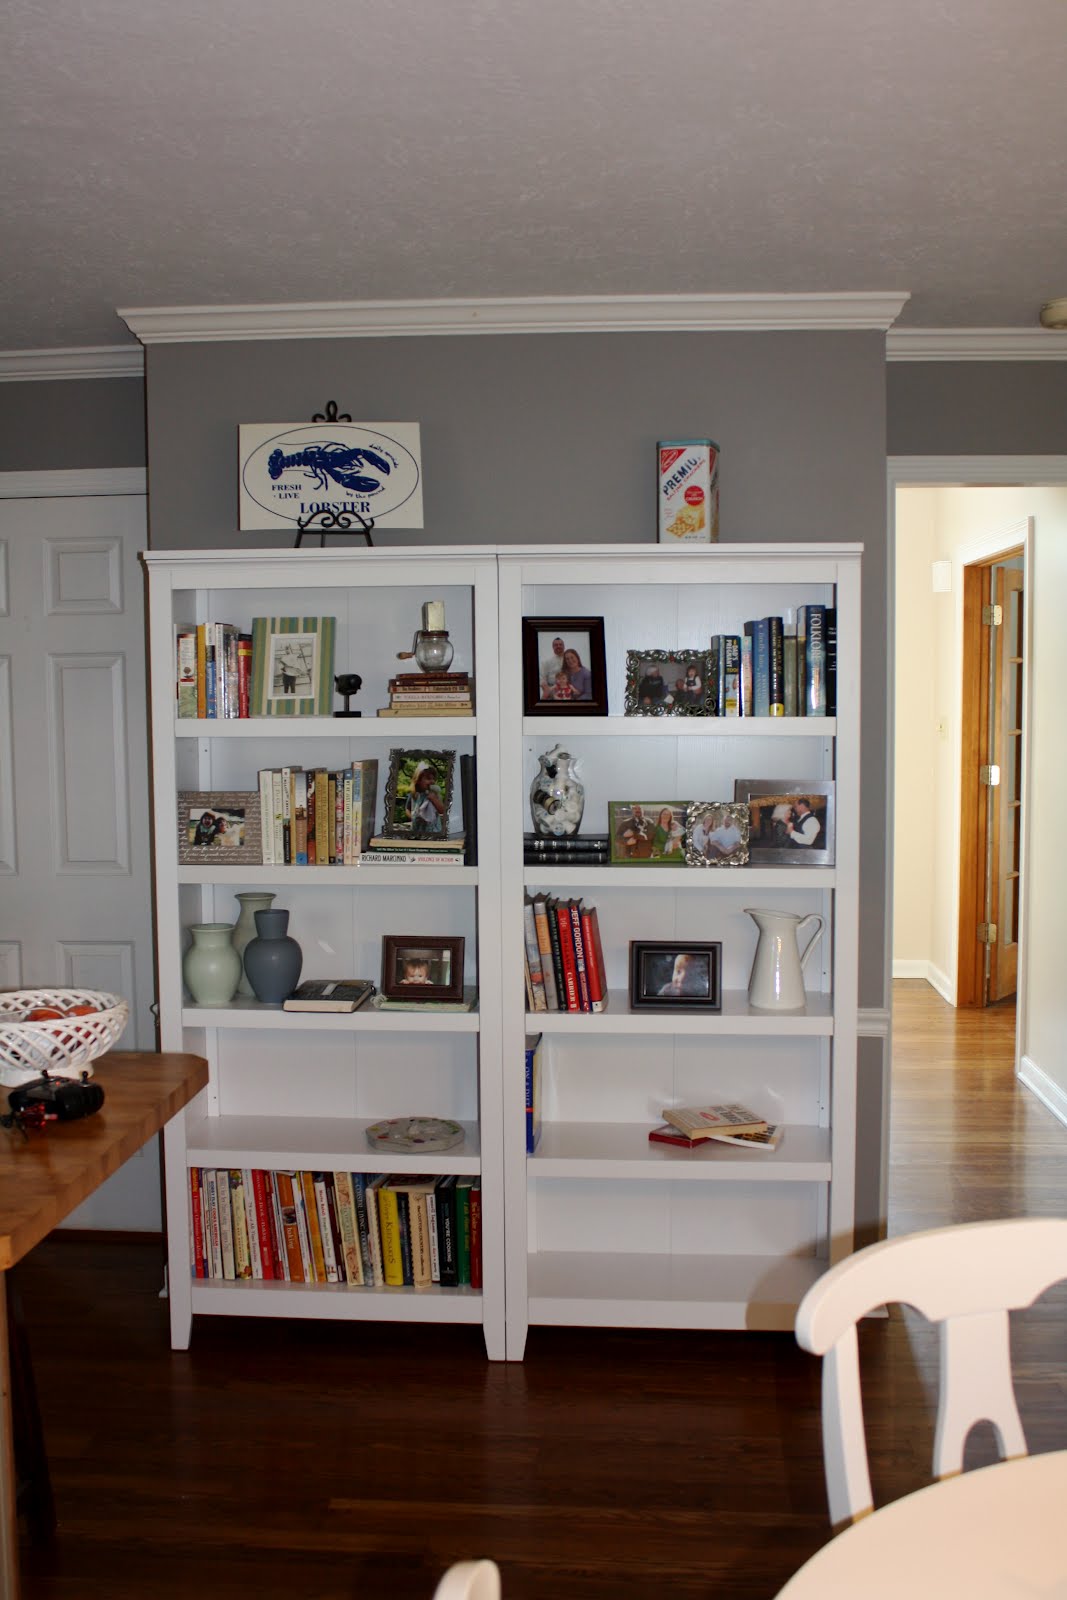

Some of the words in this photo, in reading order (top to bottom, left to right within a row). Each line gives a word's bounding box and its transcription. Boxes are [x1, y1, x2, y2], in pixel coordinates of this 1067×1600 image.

[300, 502, 370, 513] LOBSTER
[571, 909, 579, 926] JEFF
[573, 928, 584, 958] GORDON
[567, 972, 576, 1002] CARRIER
